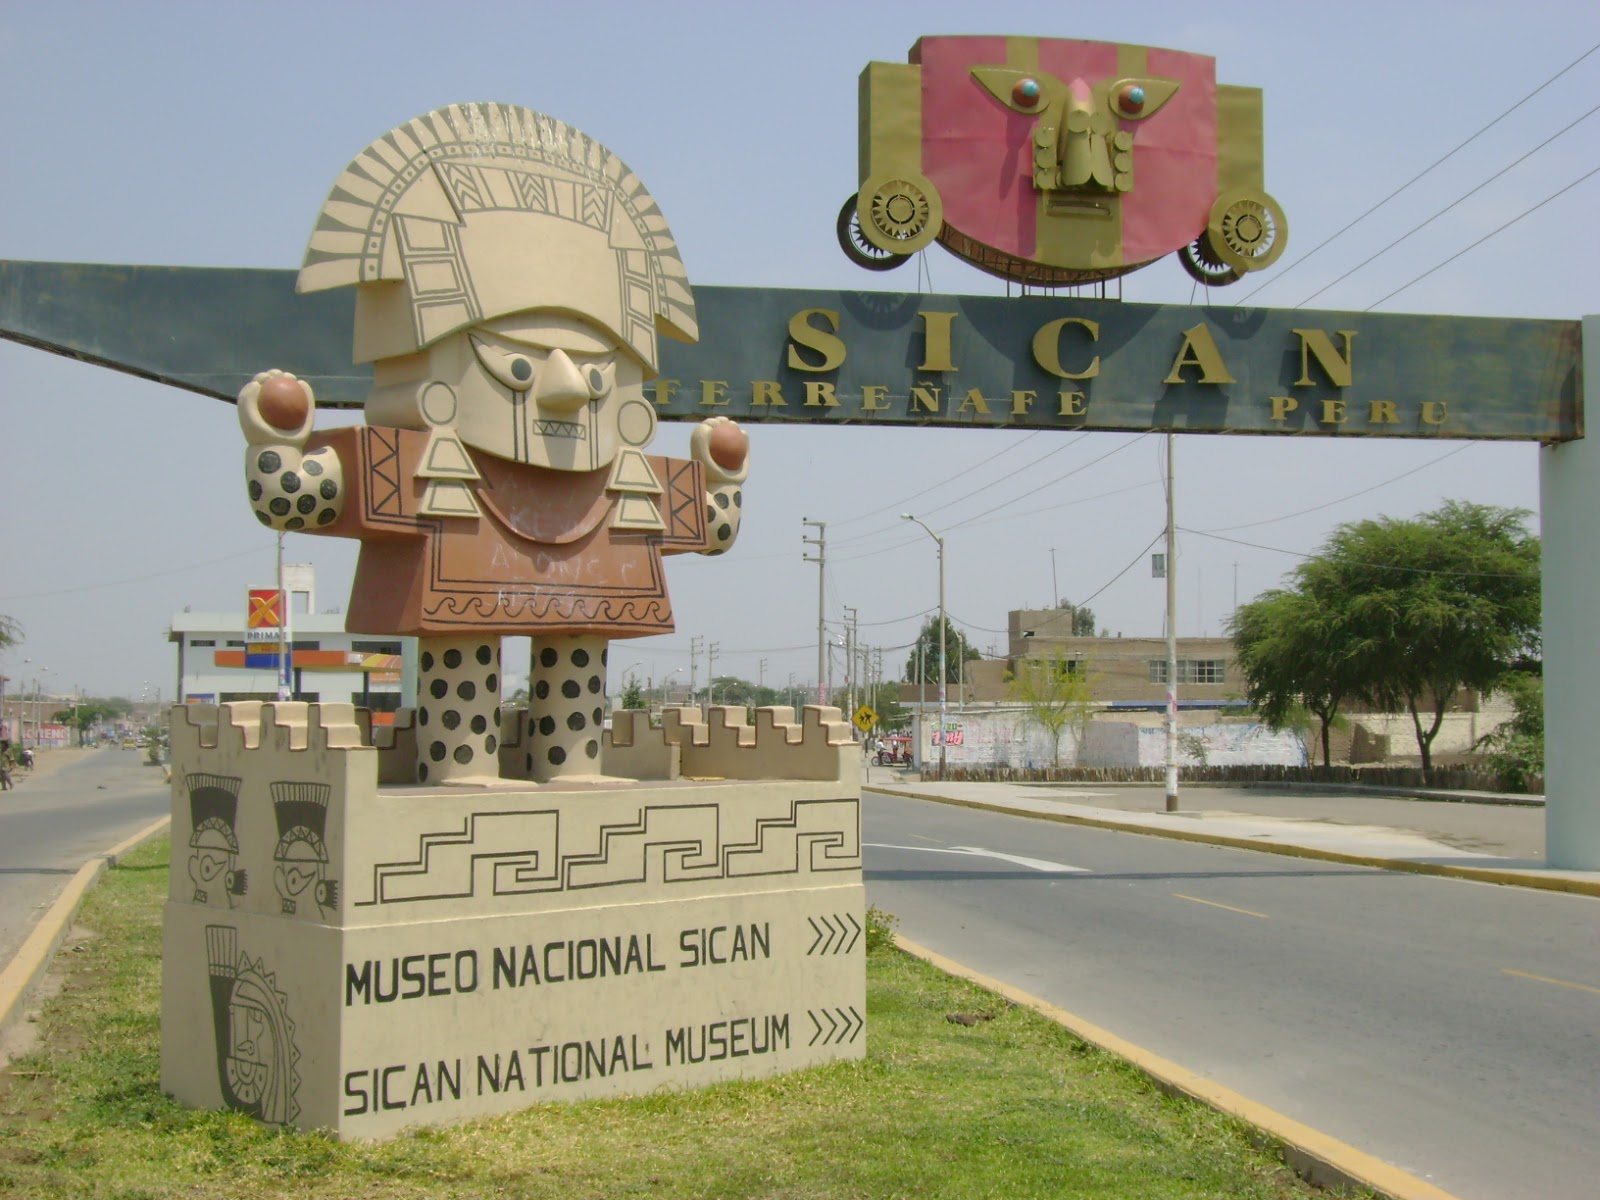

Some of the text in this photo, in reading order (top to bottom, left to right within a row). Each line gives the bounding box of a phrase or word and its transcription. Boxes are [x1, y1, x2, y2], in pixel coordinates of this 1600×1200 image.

[786, 307, 1360, 387] SICAN
[653, 379, 1448, 425] FERREÑAFE PERU
[345, 922, 771, 1007] MUSEO NACIONAL SICAN
[343, 1013, 791, 1117] SICAN NATIONAL MUSEUM
